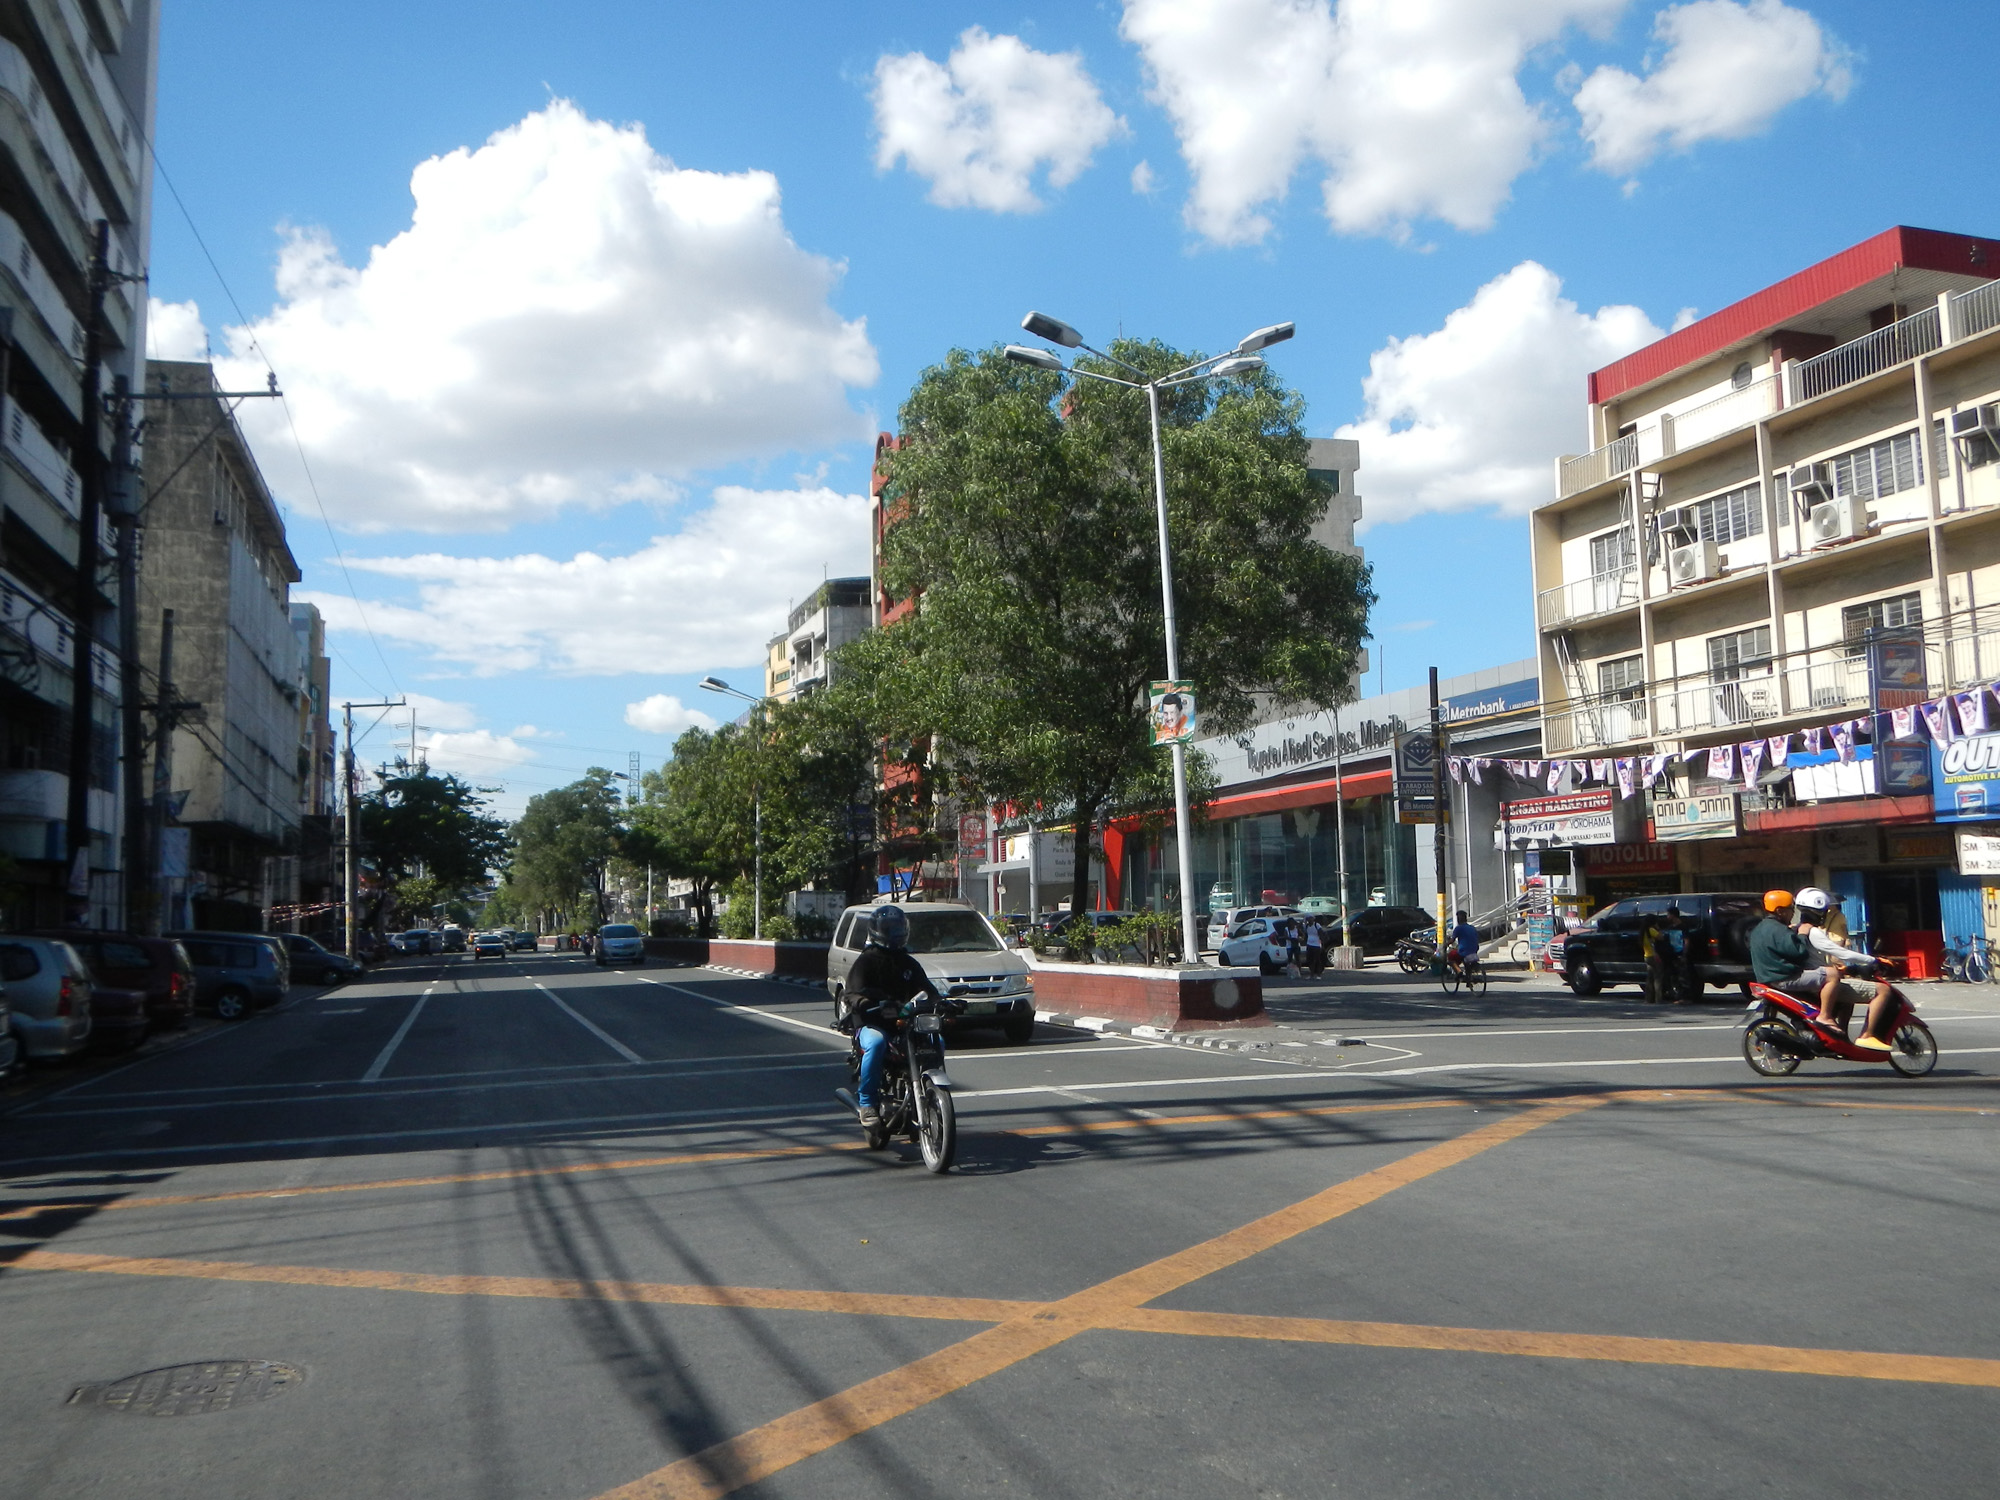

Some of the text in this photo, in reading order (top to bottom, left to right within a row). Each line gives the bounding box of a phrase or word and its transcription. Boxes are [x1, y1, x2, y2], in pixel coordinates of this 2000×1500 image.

[1450, 697, 1506, 721] Metrobank
[1246, 747, 1281, 776] Toyota
[1282, 734, 1313, 766] Abad
[1360, 714, 1408, 750] Manila
[1944, 774, 1988, 784] AUTOMOTIVE
[1545, 794, 1609, 812] MARKETING
[1700, 797, 1732, 821] 2000
[1569, 816, 1612, 830] YOKOHAMA
[1589, 843, 1669, 864] MOTOLITE
[1963, 842, 1978, 852] SM
[1965, 860, 1979, 870] SM
